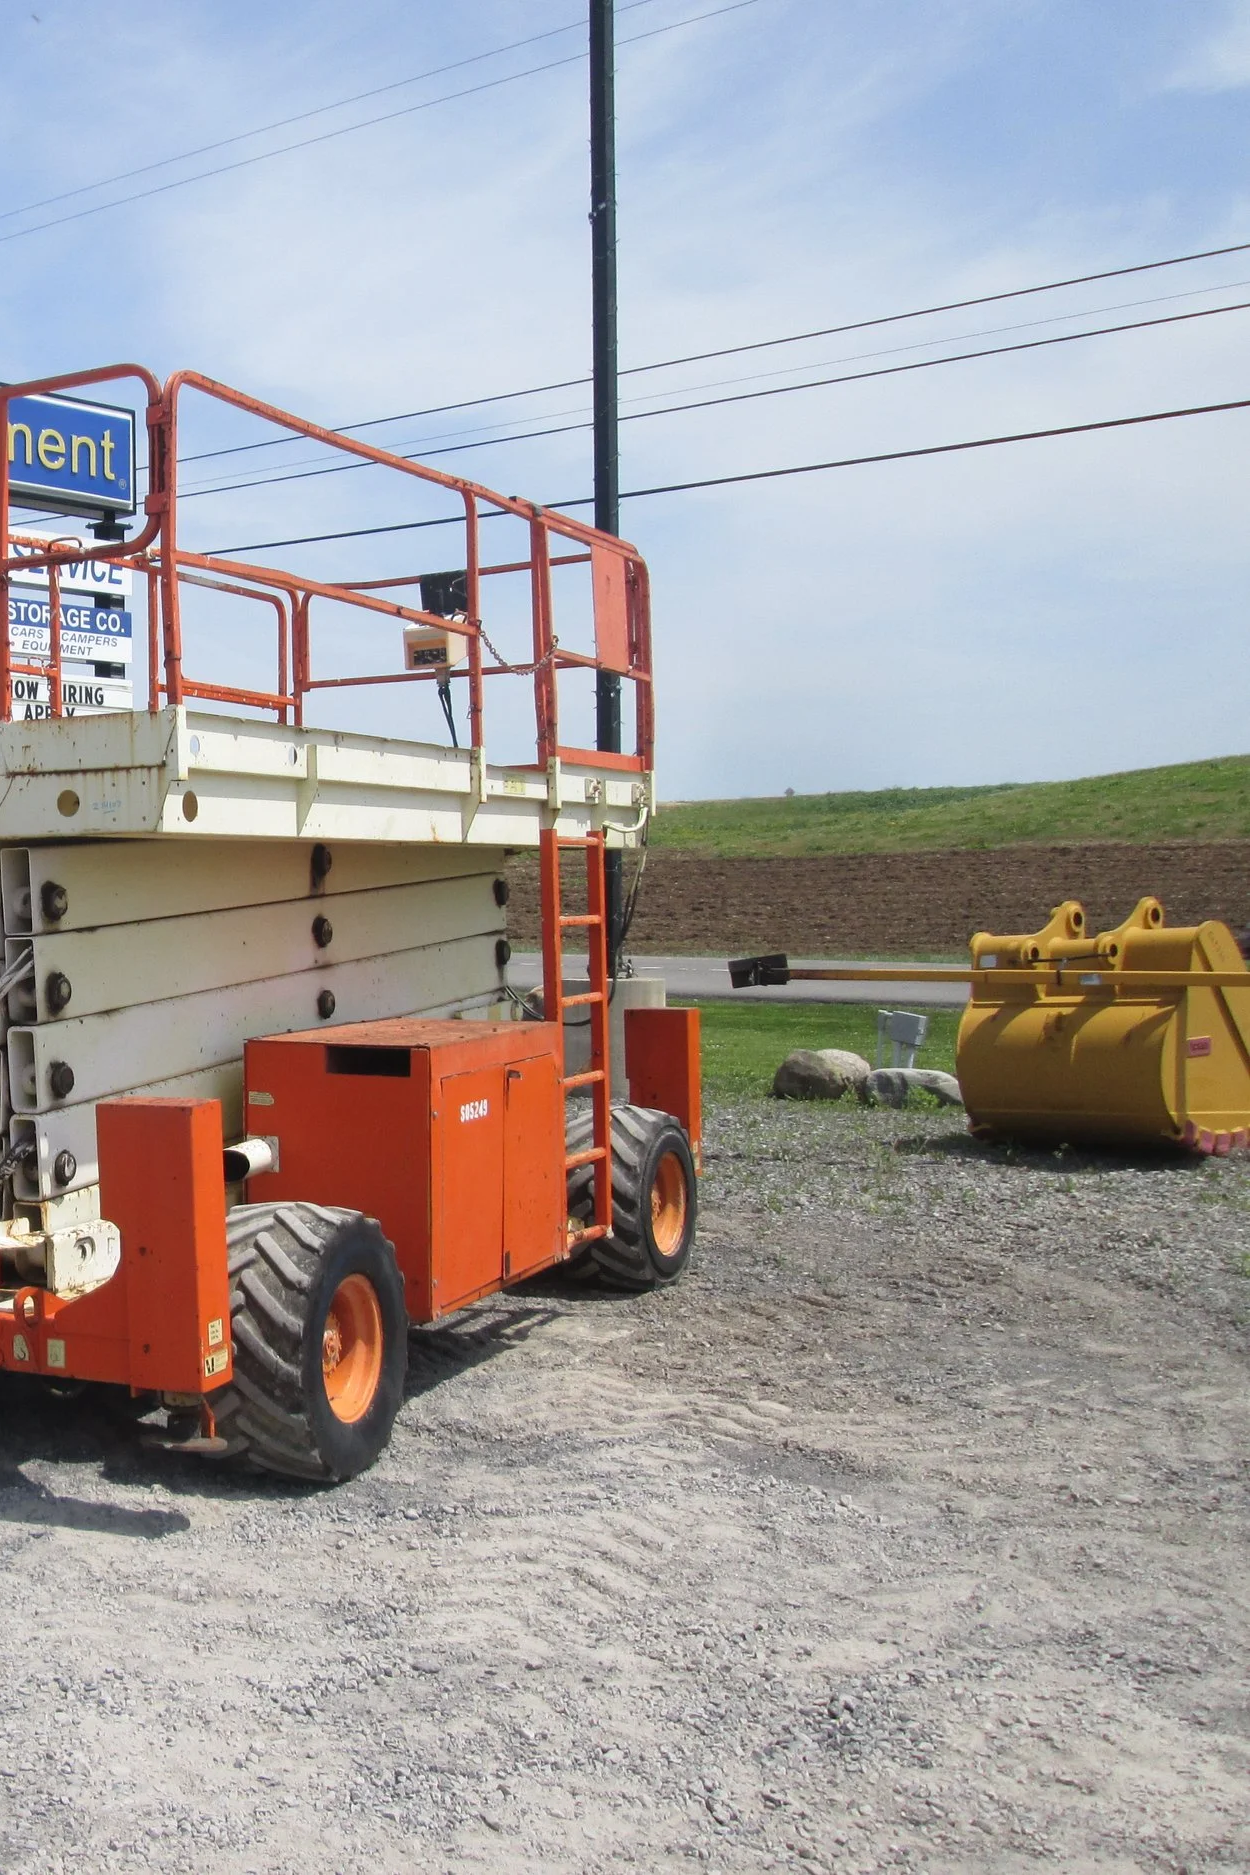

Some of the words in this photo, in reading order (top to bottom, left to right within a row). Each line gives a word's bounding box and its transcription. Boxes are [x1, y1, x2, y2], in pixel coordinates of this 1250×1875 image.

[96, 611, 125, 633] CO.
[11, 626, 44, 639] CARS
[61, 631, 118, 647] CAMPERS
[21, 640, 93, 656] EQUIMENT
[10, 679, 39, 700] OW
[62, 684, 104, 706] IRING
[24, 703, 76, 720] APPY
[460, 1098, 488, 1123] S05249
